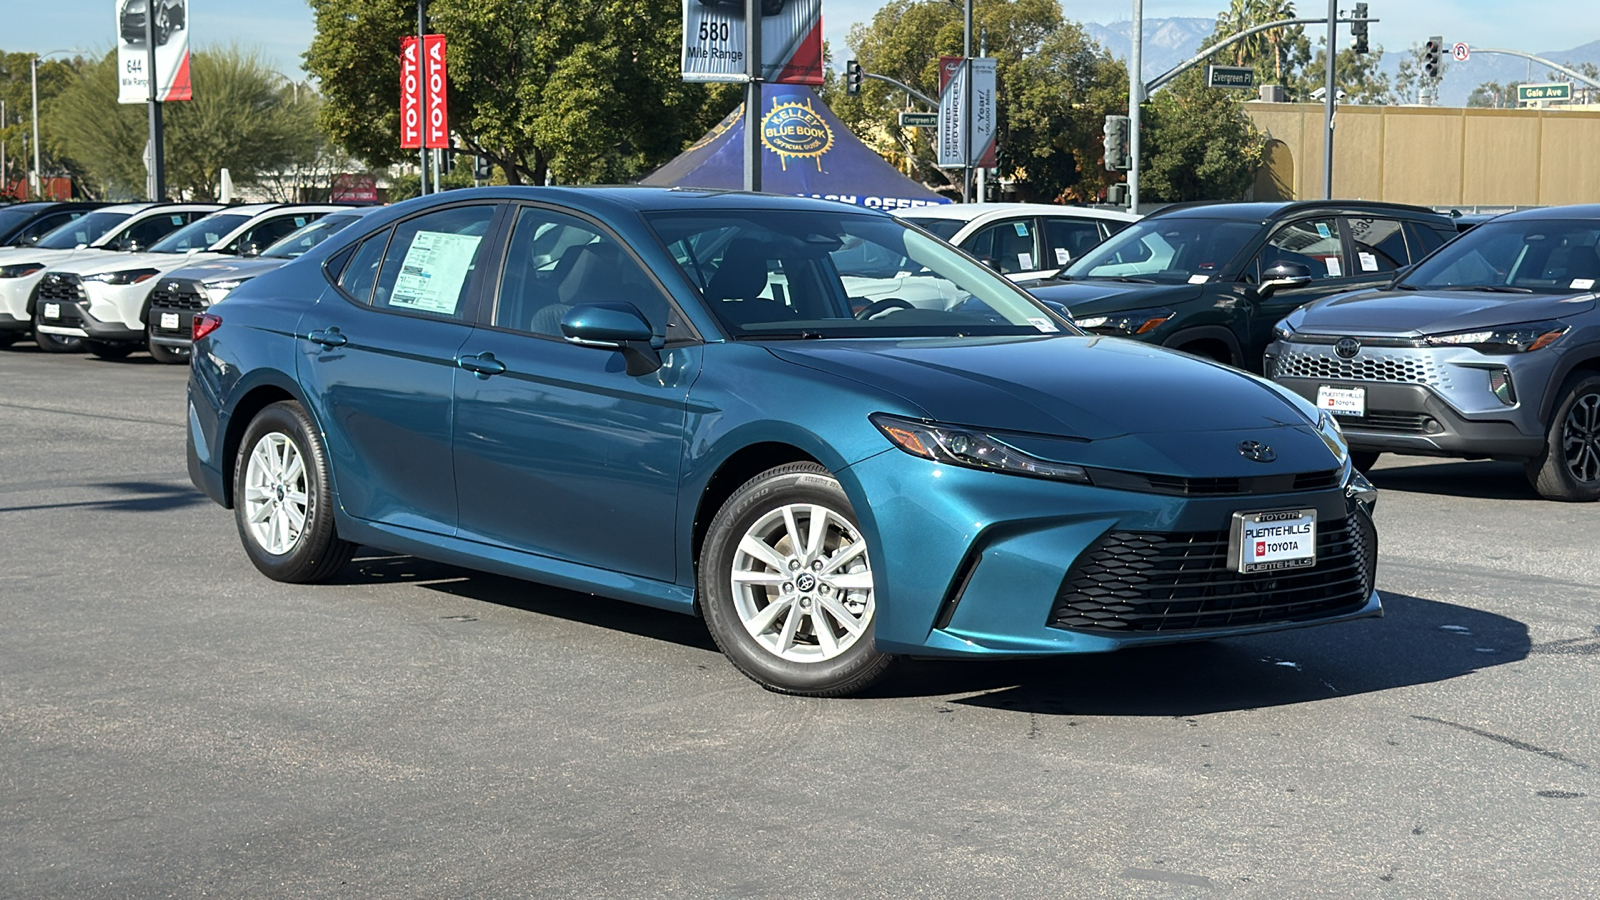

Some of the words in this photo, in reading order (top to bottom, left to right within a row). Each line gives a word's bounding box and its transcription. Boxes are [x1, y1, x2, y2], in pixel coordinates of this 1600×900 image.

[699, 22, 729, 41] 580
[687, 47, 709, 59] Mile
[711, 48, 743, 62] Range
[127, 59, 142, 74] 644
[133, 78, 149, 88] Rang
[1213, 72, 1243, 85] Evergreen
[405, 43, 418, 142] TOYOTA
[430, 42, 443, 142] TOYOTA
[1526, 89, 1543, 98] Gale
[1546, 88, 1562, 97] Ave
[977, 89, 985, 123] Year/
[771, 109, 820, 125] KELLEY
[766, 126, 795, 138] BLUE
[796, 126, 826, 139] BOOK
[978, 126, 984, 134] 7
[773, 138, 804, 150] OFFICIAL
[1262, 511, 1299, 522] TOYOTA
[1245, 526, 1282, 539] PUENTE
[1283, 524, 1311, 536] HILLS
[1267, 541, 1299, 553] TOYOTA
[1246, 561, 1284, 572] PUENTE
[1284, 558, 1312, 569] HILLS
